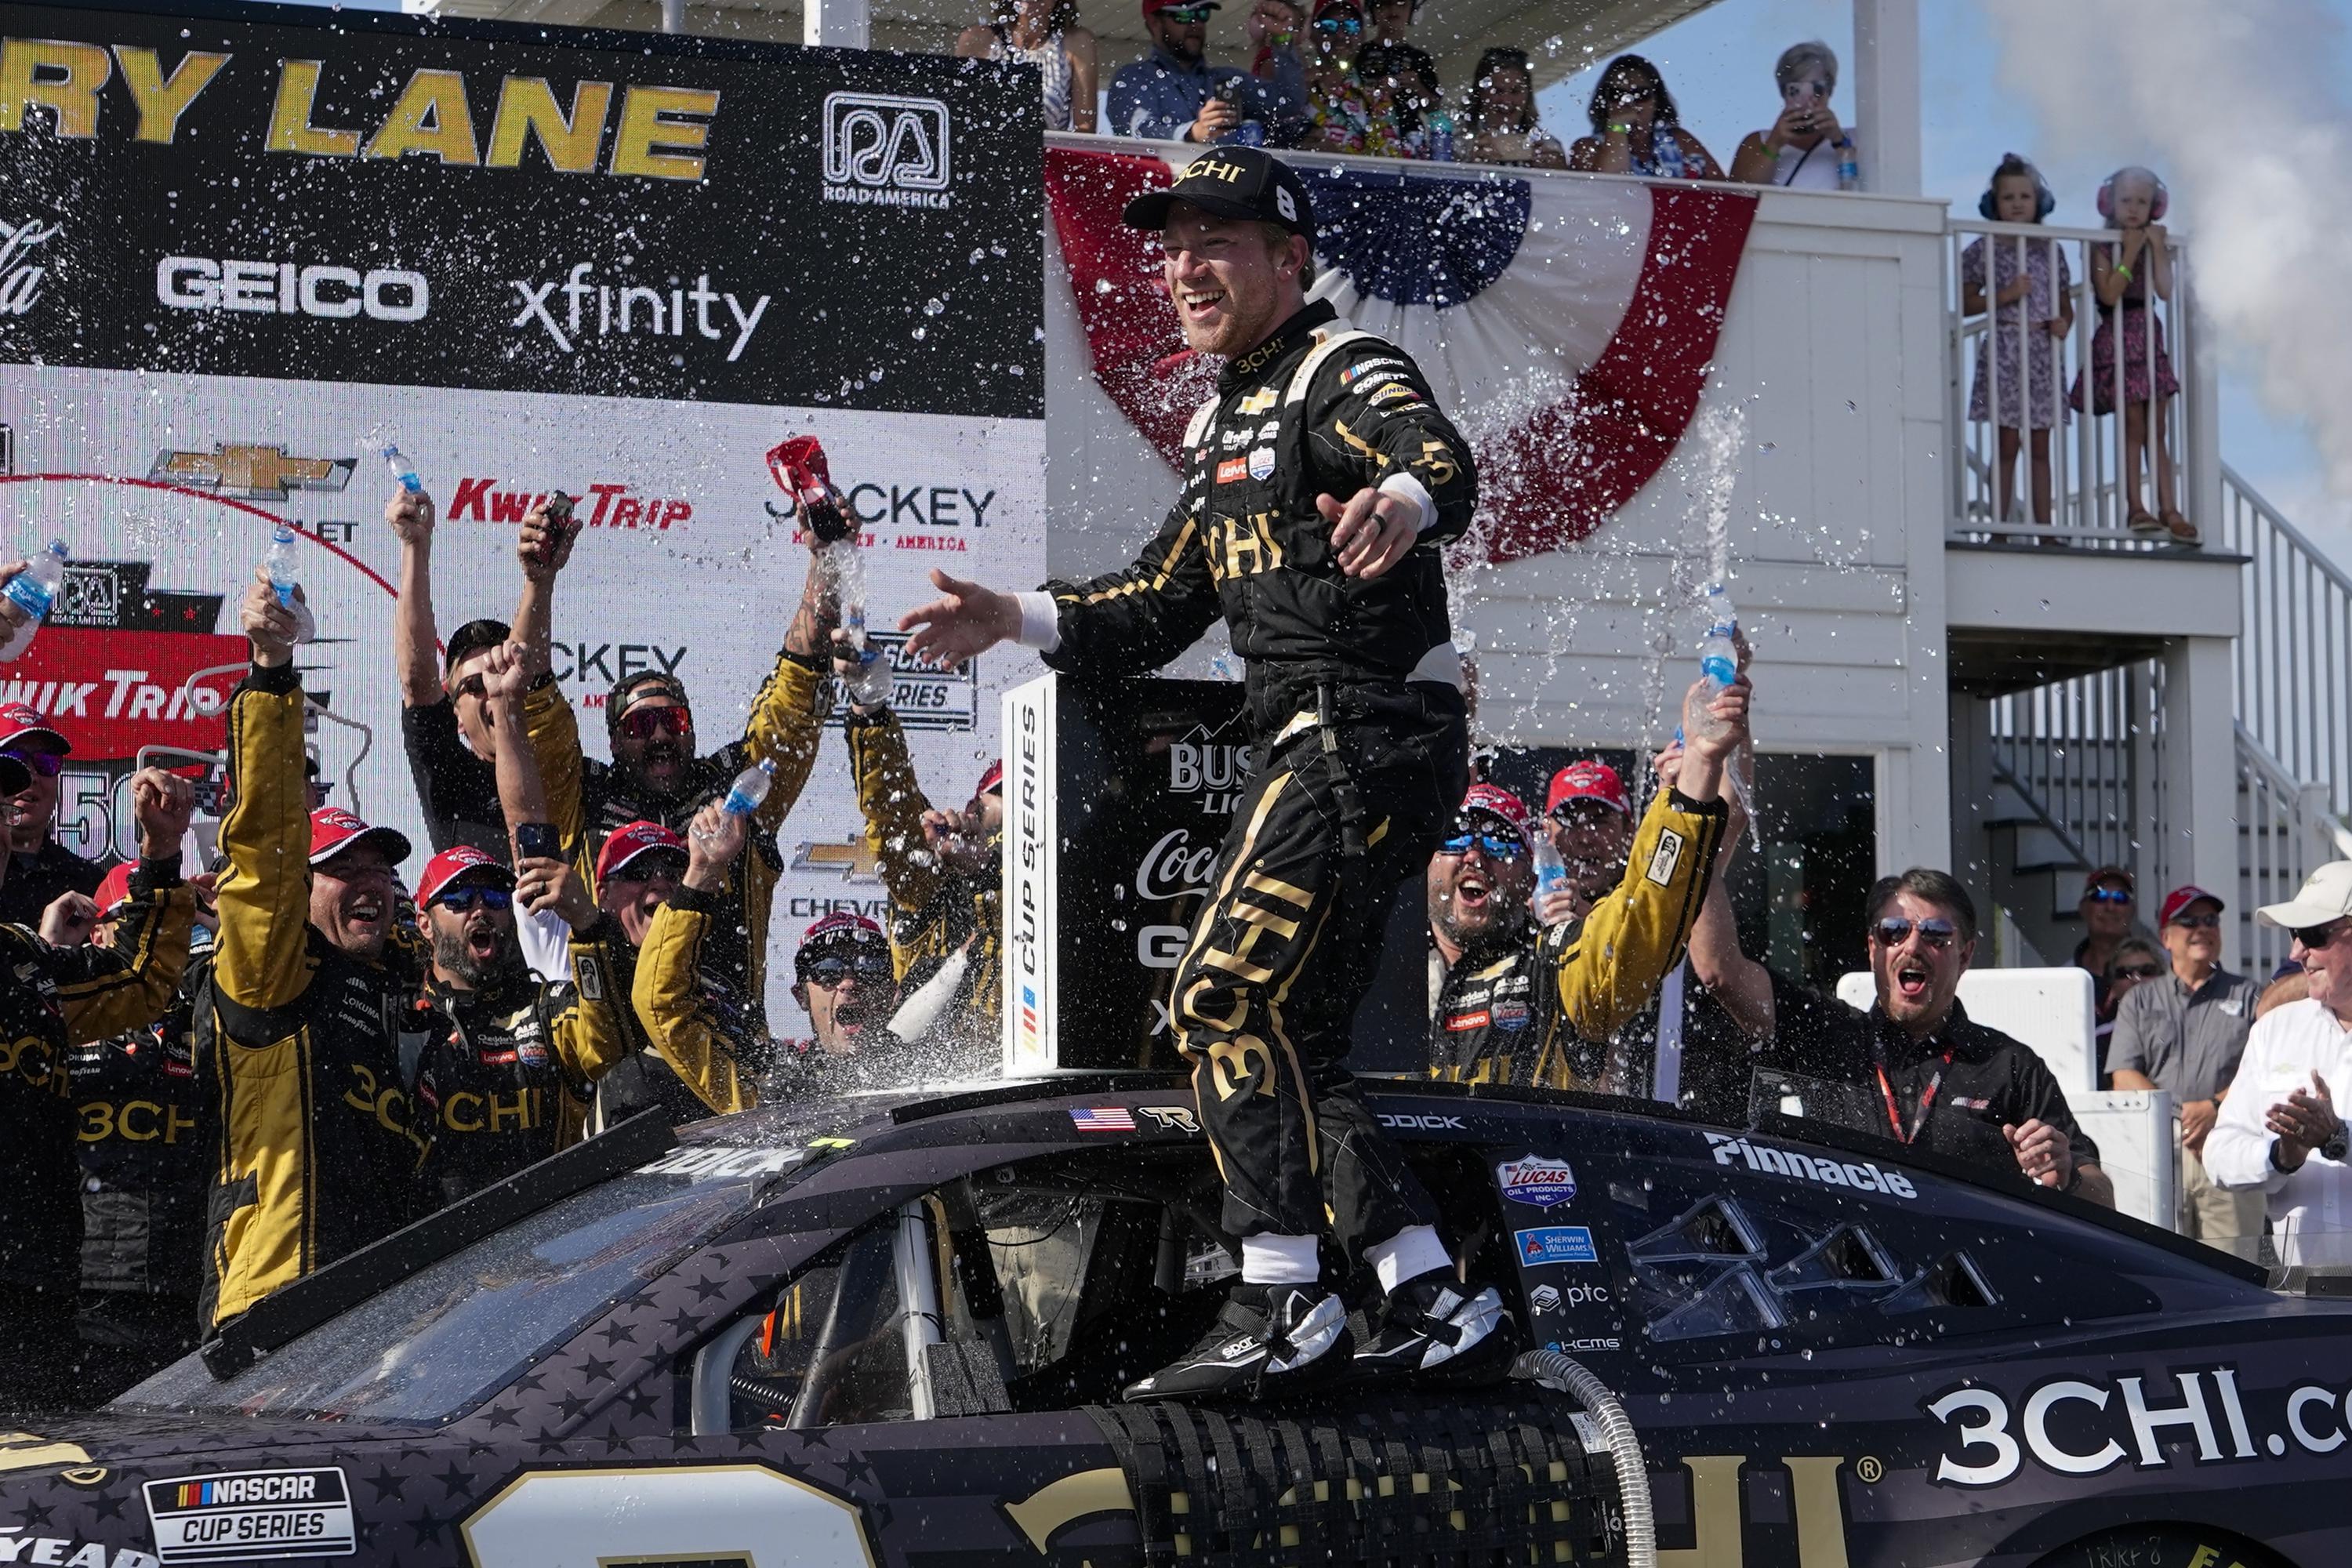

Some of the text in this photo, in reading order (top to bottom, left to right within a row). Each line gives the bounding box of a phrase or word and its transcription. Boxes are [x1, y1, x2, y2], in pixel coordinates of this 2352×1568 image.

[264, 59, 720, 182] LANE
[824, 186, 950, 211] ROAD AMERICA
[1276, 185, 1298, 222] 8
[158, 256, 429, 321] GEICO
[511, 262, 771, 361] xfinity
[1236, 338, 1286, 374] 3CHI
[765, 483, 996, 527] JCKEY
[896, 535, 967, 551] AMERICA
[550, 642, 687, 683] CKEY
[0, 679, 98, 718] WIK
[1168, 744, 1253, 793] BUS
[1022, 703, 1036, 976] CUP SERIES
[1450, 1015, 1486, 1028] Lenovo
[484, 1053, 514, 1062] Lenovo
[77, 1101, 194, 1144] 3CH
[444, 1087, 541, 1132] CHI
[1510, 1171, 1568, 1186] LUCAS
[1701, 1131, 1918, 1199] Pinnacle
[1526, 1185, 1574, 1194] PRODUCTS
[1544, 1235, 1584, 1244] SHERWIN
[1566, 1282, 1609, 1308] ptc
[1222, 1336, 1257, 1359] spar
[1561, 1338, 1620, 1351] KCMG
[212, 1475, 315, 1504] NASCAR
[183, 1512, 325, 1543] CUP SERIES
